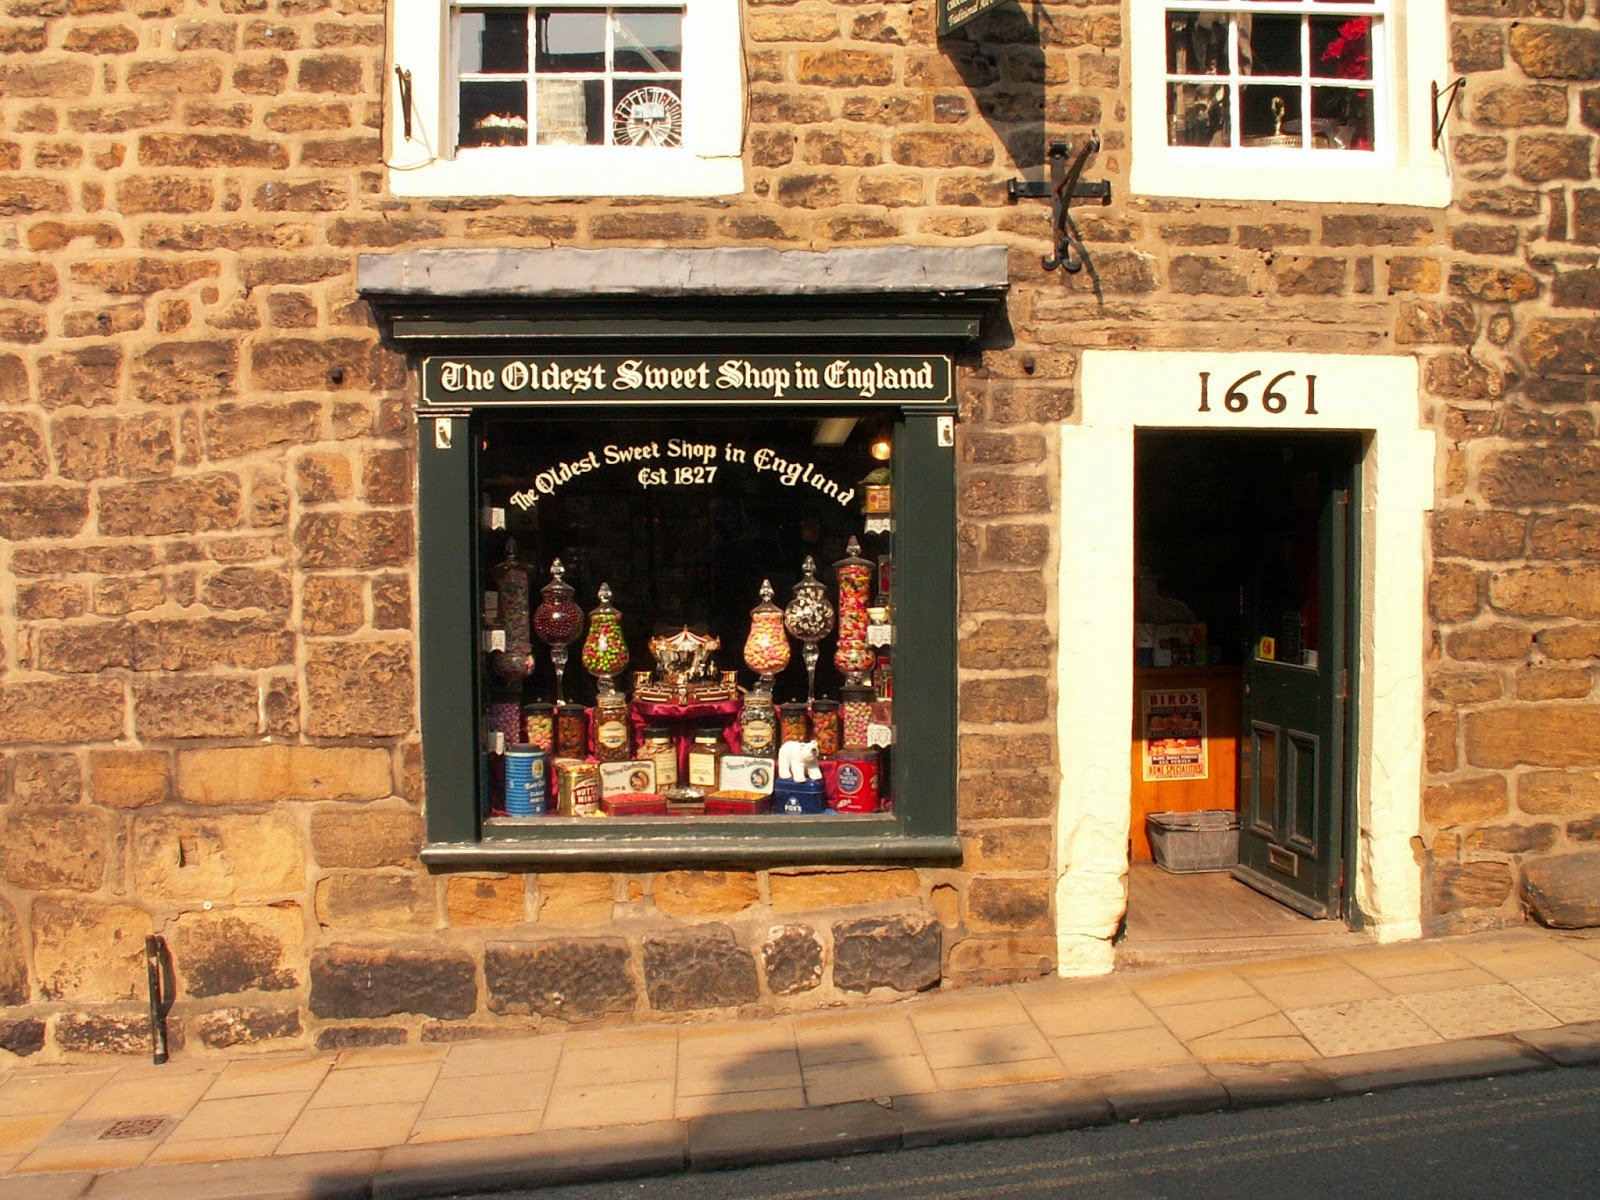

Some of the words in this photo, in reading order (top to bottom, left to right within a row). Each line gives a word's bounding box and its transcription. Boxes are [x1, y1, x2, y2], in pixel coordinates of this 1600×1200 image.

[441, 361, 495, 392] The
[501, 360, 607, 394] Oldest
[612, 359, 710, 391] Sweet
[714, 359, 791, 397] Shop
[794, 361, 819, 388] in
[824, 359, 936, 398] England
[1197, 369, 1320, 415] 1661
[508, 487, 539, 512] The
[534, 450, 602, 495] Oldest
[603, 441, 661, 465] Sweet
[666, 438, 718, 464] Shop
[724, 442, 746, 464] in
[752, 447, 857, 508] England
[637, 467, 669, 490] Est
[673, 465, 719, 487] 1827
[1165, 764, 1202, 775] SPECIALITIES
